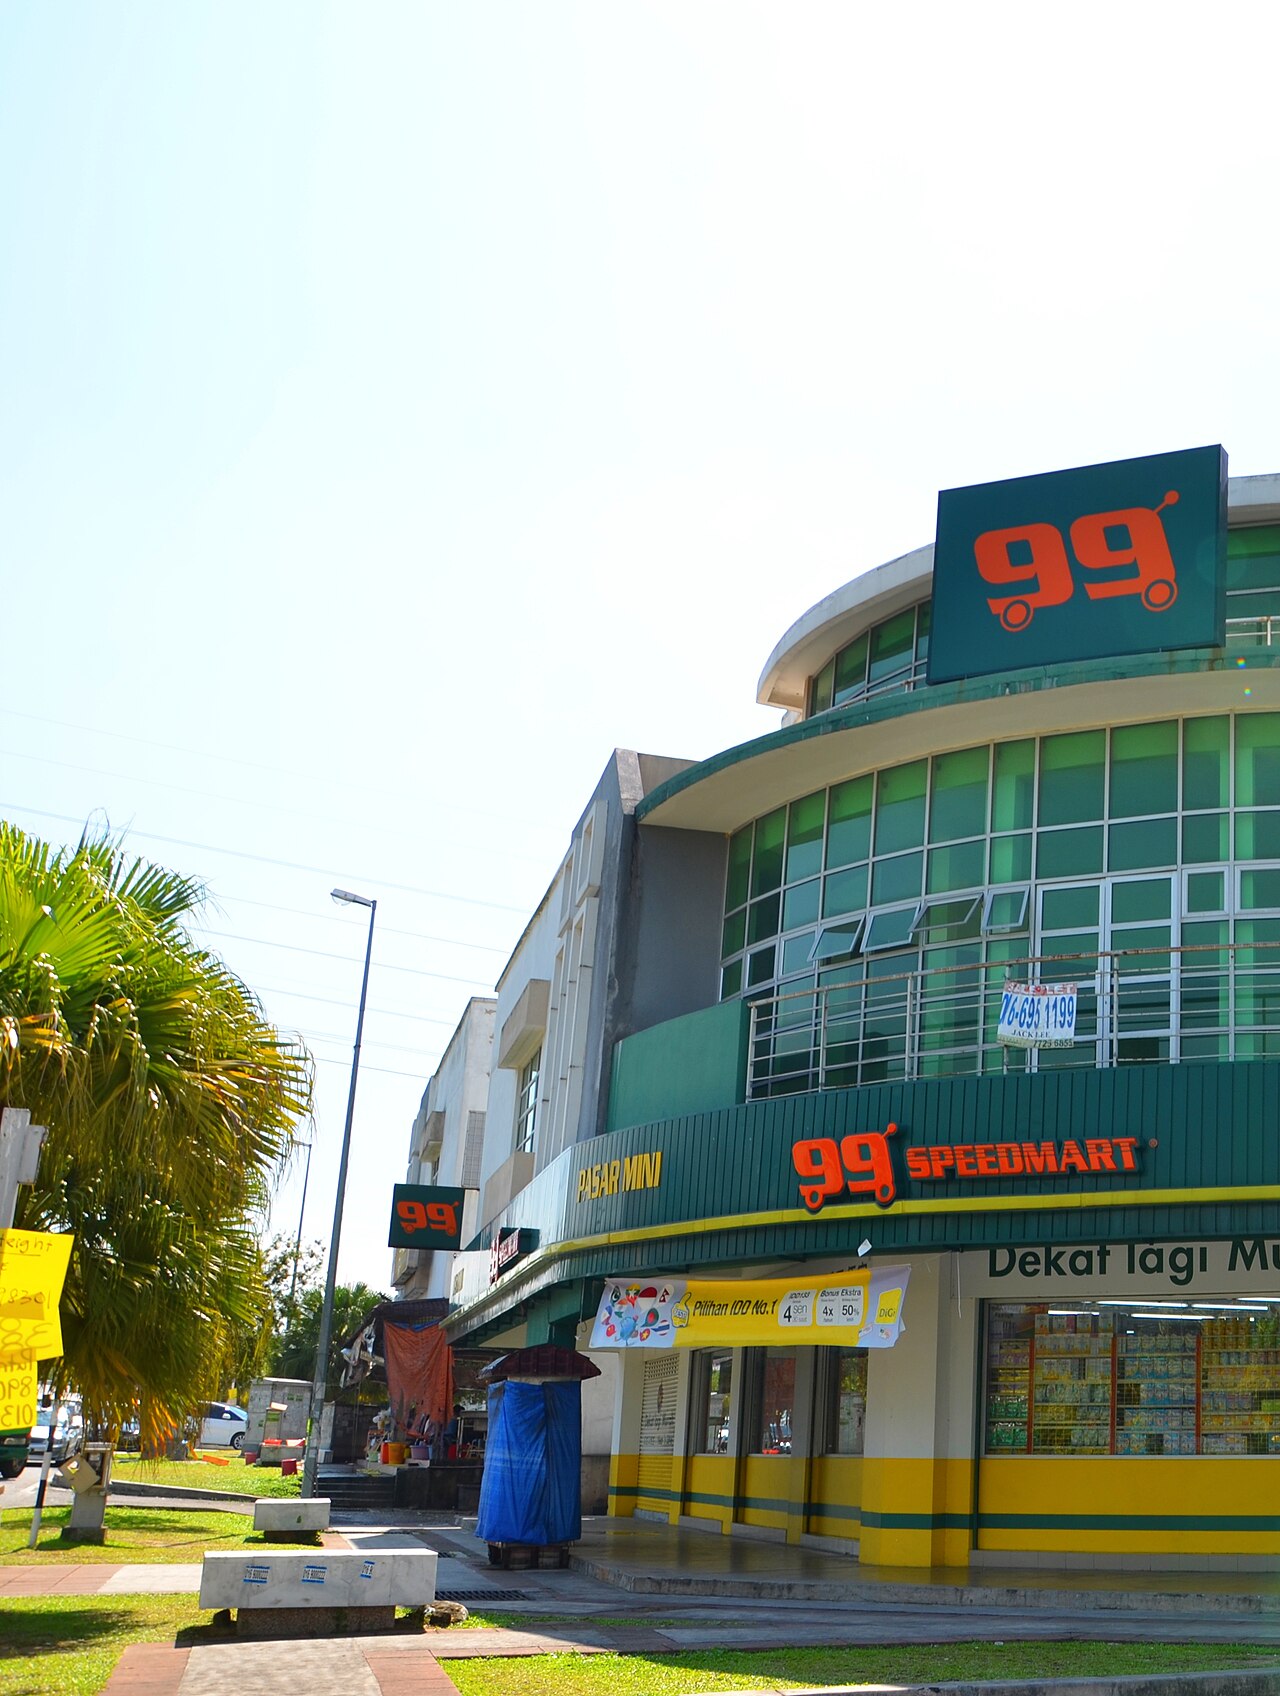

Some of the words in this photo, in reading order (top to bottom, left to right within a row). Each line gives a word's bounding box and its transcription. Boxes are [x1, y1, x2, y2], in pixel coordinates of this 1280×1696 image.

[973, 489, 1180, 633] 99
[1046, 984, 1074, 995] LET
[1045, 995, 1074, 1029] 1199
[1012, 1029, 1033, 1038] JACK
[792, 1122, 897, 1209] 99
[906, 1137, 1138, 1179] SPEEDMART
[576, 1159, 620, 1203] PASAR
[622, 1151, 662, 1192] MINI
[396, 1200, 459, 1236] 99
[988, 1246, 1110, 1278] Dekat
[1127, 1243, 1207, 1286] lagi
[841, 1288, 861, 1296] Ekstra
[693, 1300, 728, 1317] Pilihan
[730, 1299, 751, 1316] IDD
[751, 1299, 778, 1315] No.1
[783, 1305, 792, 1322] 4
[793, 1304, 808, 1314] sen
[822, 1305, 834, 1316] 4x
[842, 1304, 860, 1316] 50%
[879, 1308, 896, 1318] DiGi
